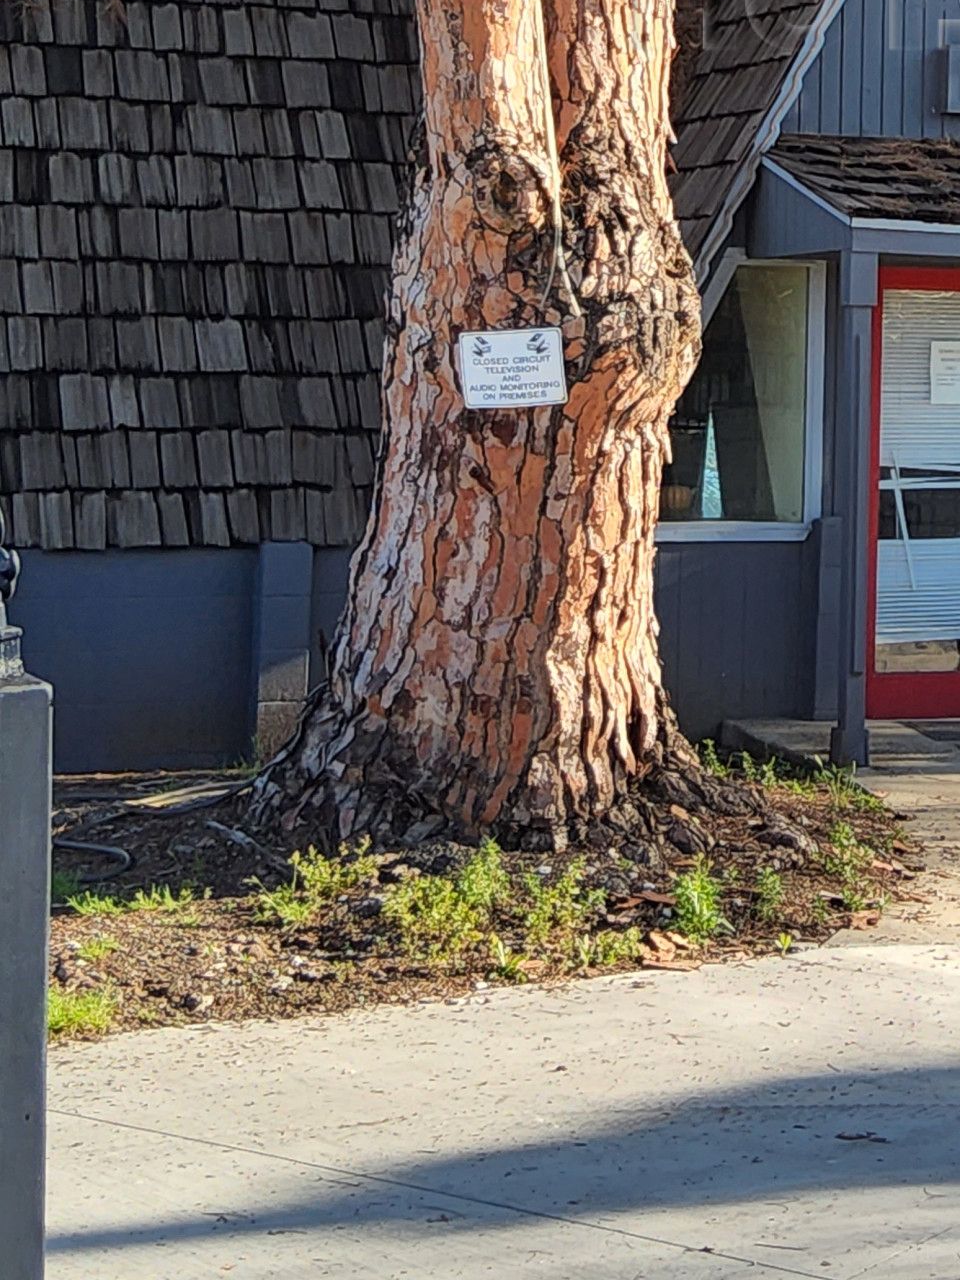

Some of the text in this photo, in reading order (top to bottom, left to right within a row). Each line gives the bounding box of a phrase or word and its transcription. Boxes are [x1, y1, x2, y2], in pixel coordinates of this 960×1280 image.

[472, 354, 551, 366] CLOSED CIRCUIT
[485, 365, 539, 374] TELEVISION
[502, 374, 521, 382] AND
[469, 380, 560, 392] AUDIO MONITORING
[482, 390, 547, 400] ON PREMISES
